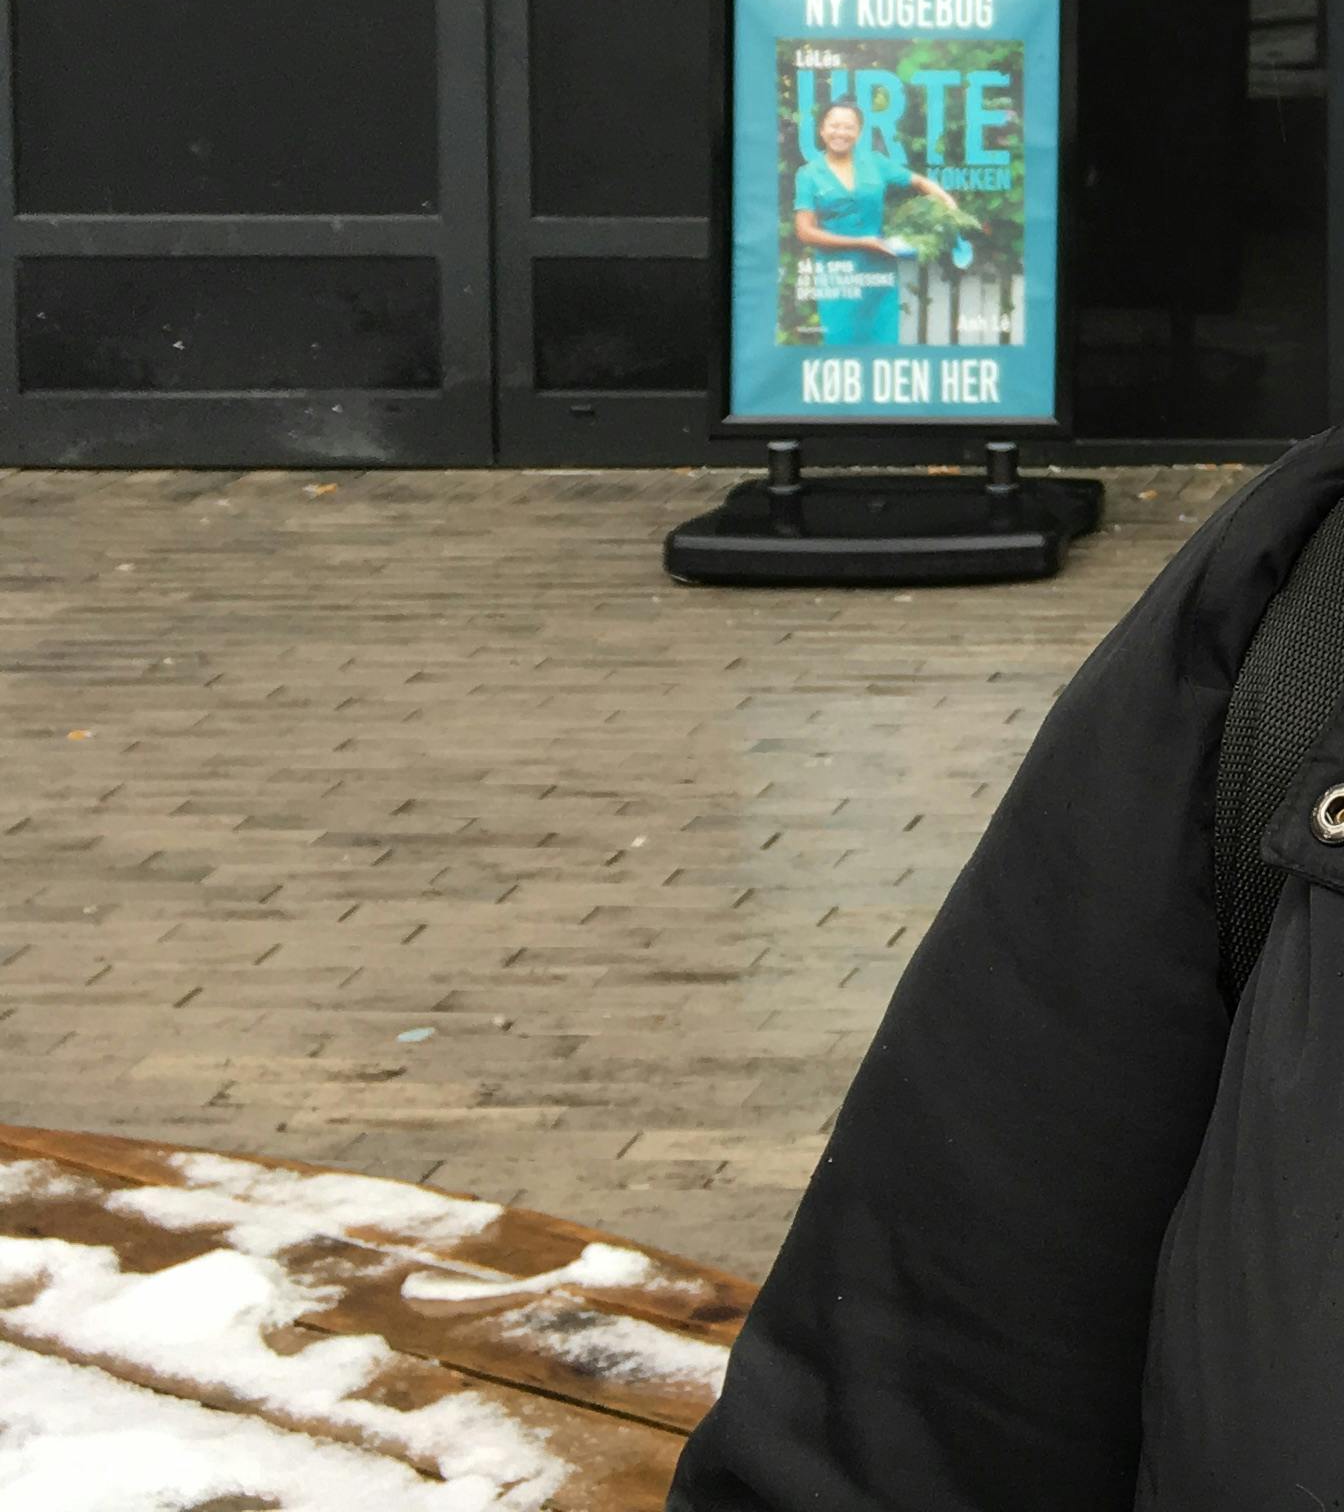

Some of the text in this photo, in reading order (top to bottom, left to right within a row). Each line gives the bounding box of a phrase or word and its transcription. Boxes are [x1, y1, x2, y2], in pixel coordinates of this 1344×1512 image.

[796, 68, 1011, 166] URTE
[803, 358, 999, 403] KØB DEN HER
